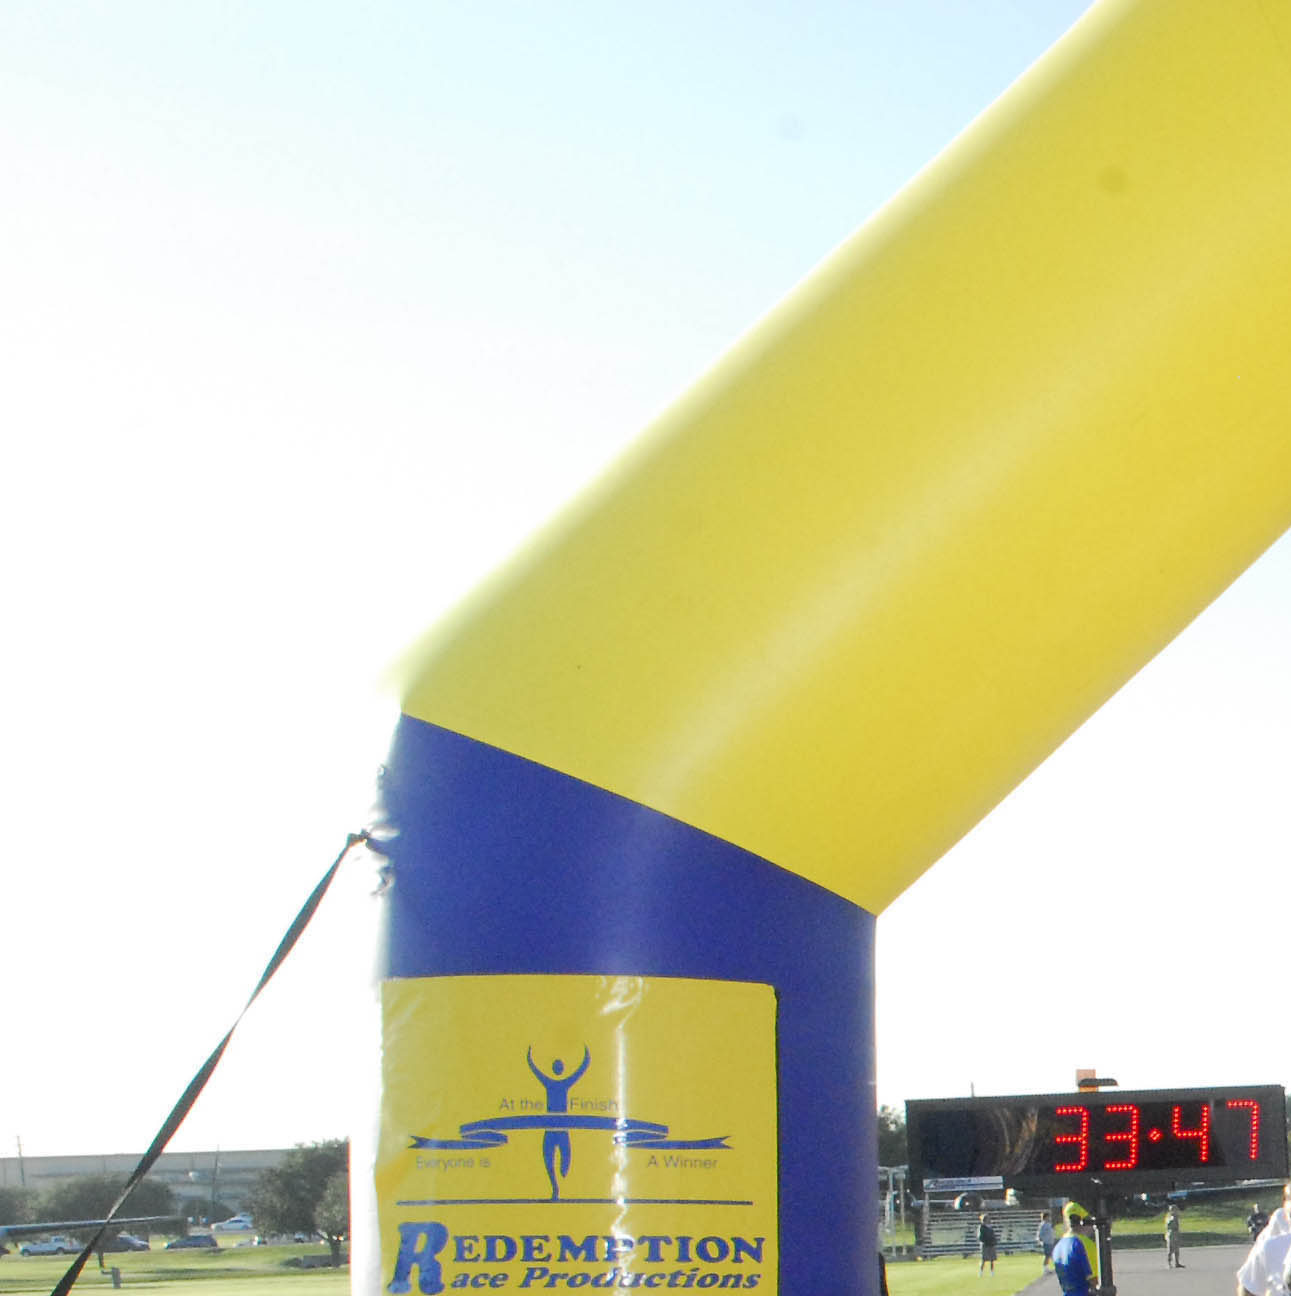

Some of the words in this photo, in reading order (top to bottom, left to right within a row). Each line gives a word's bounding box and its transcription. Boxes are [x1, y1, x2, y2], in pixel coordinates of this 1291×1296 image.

[499, 1097, 516, 1112] At
[519, 1097, 545, 1112] the
[386, 1220, 765, 1296] REDEMPTION
[517, 1265, 762, 1290] Productions
